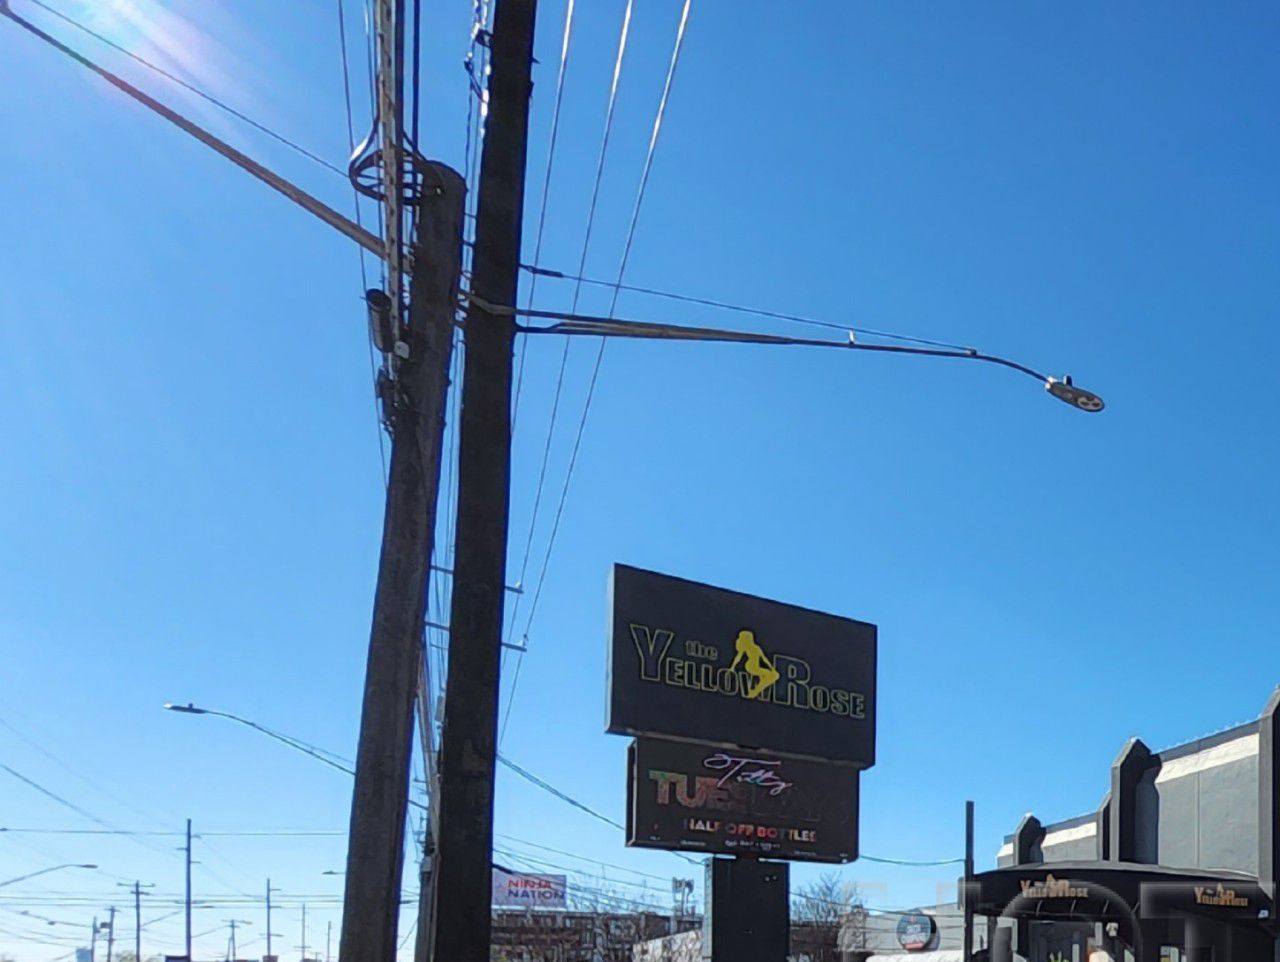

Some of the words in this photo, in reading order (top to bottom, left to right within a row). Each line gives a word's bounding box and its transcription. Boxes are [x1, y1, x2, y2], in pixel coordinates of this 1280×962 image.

[772, 654, 865, 719] ROSE
[725, 823, 752, 836] OFF
[508, 889, 565, 900] NATION
